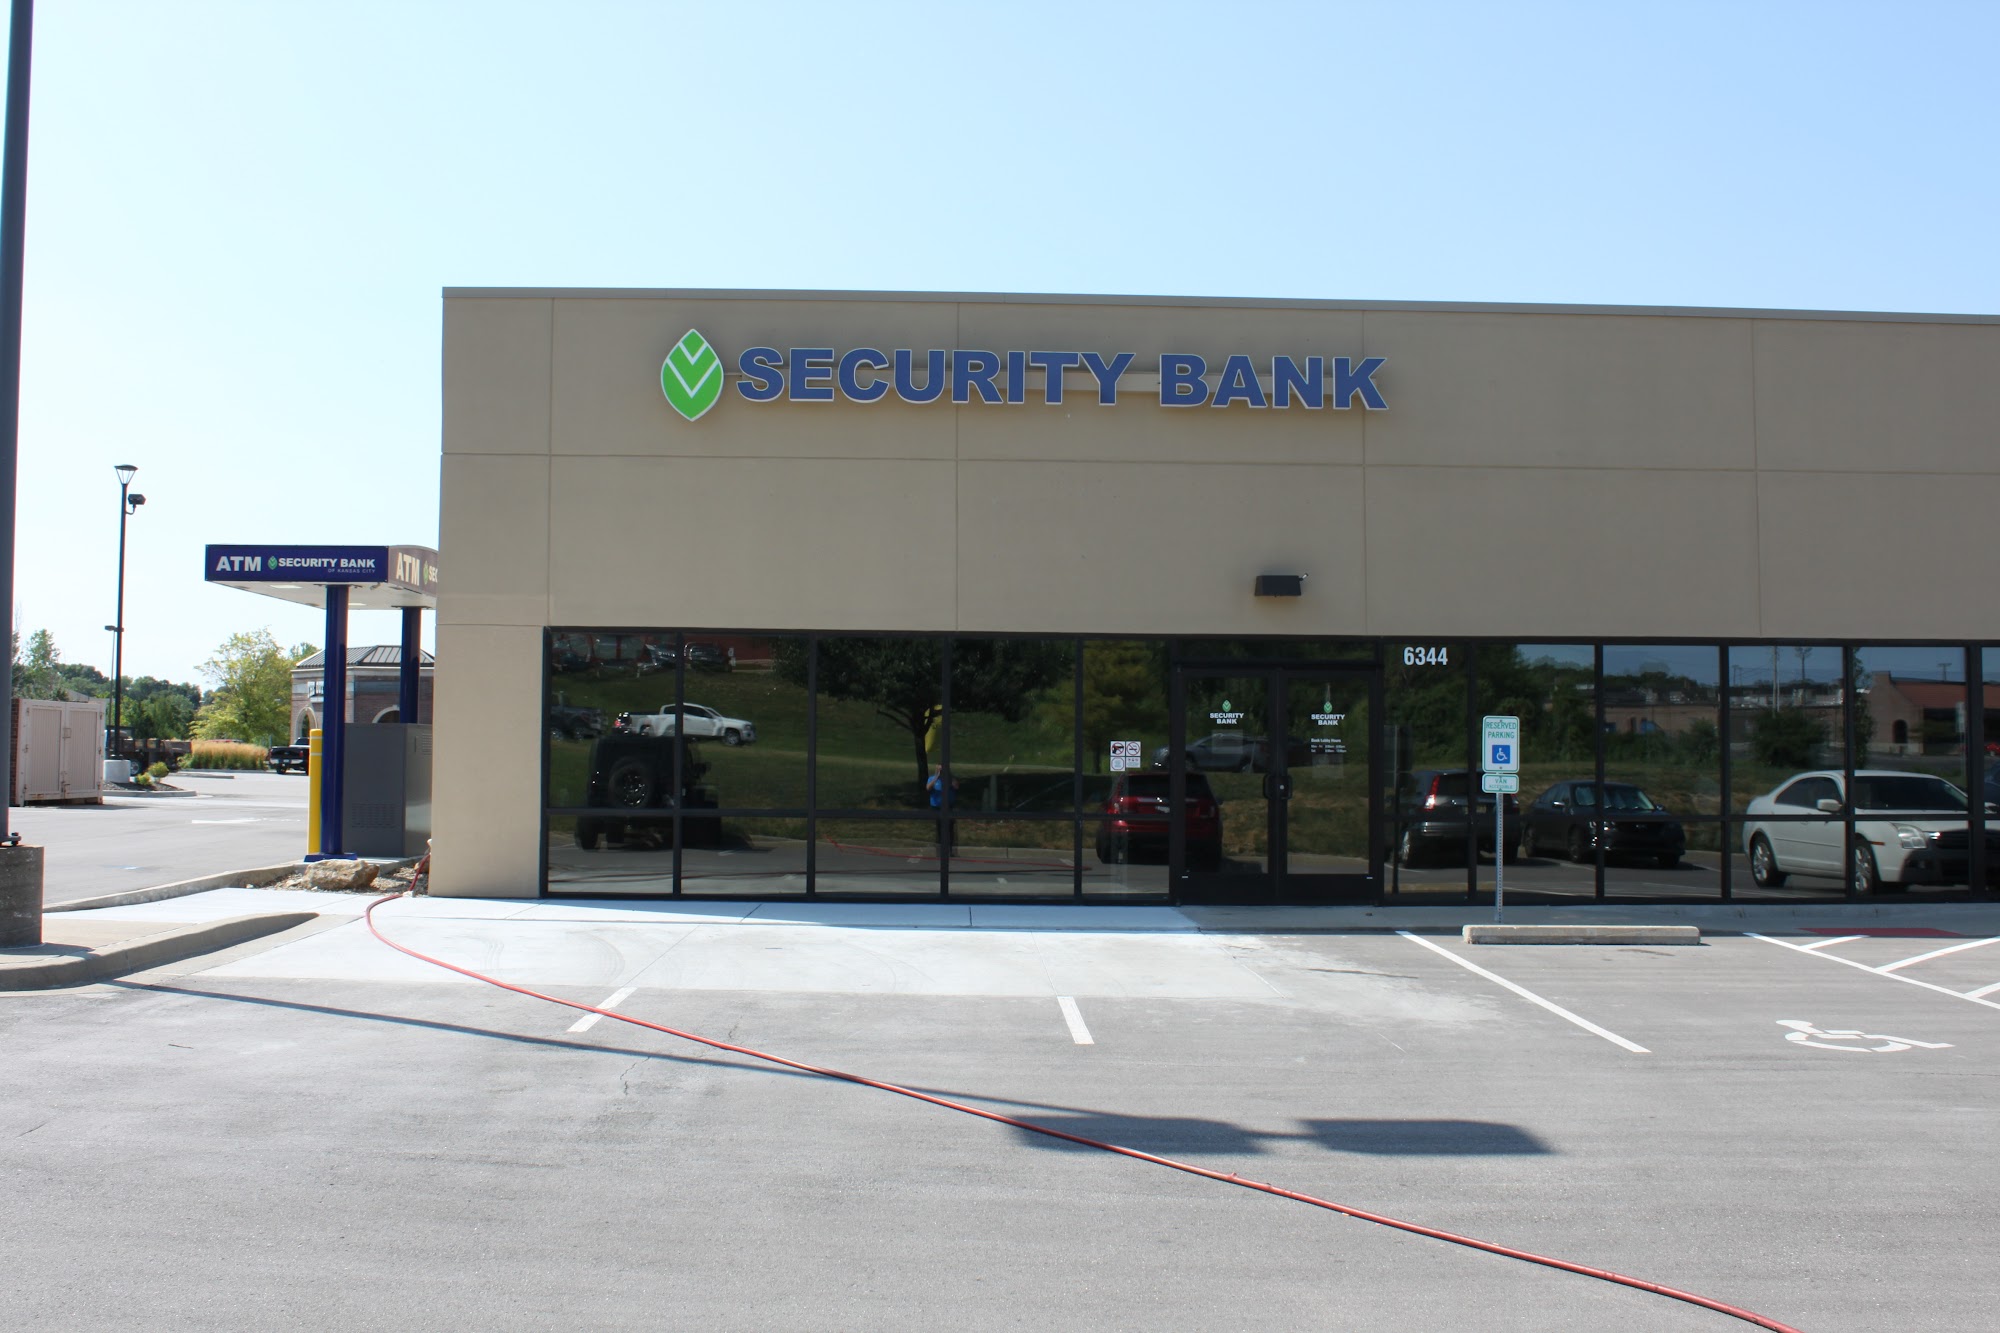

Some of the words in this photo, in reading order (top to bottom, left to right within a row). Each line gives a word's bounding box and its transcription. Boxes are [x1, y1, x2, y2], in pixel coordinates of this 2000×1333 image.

[736, 347, 1136, 405] SECURITY
[1160, 353, 1389, 410] BANK
[216, 555, 262, 572] ATM
[278, 557, 338, 568] SECURITY
[340, 558, 376, 568] BANK
[396, 552, 420, 586] ATM
[1403, 646, 1448, 665] 6344
[1488, 731, 1514, 739] PARKING
